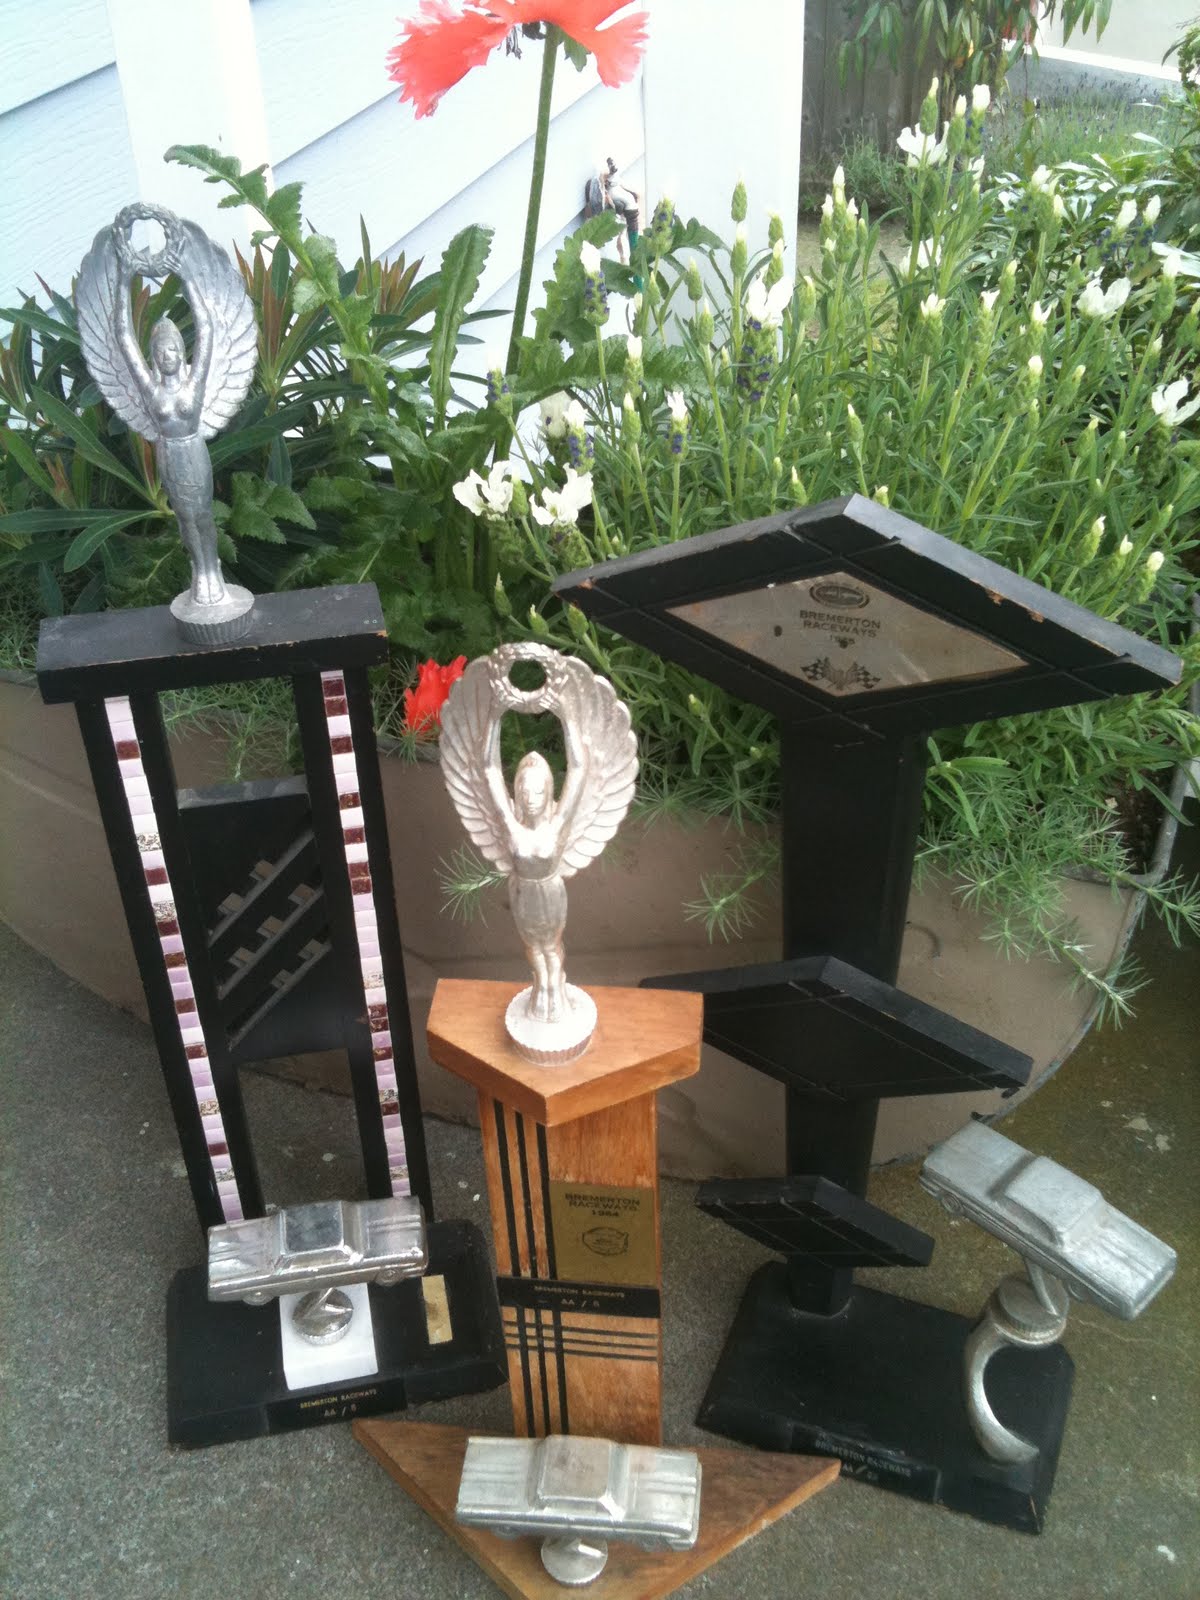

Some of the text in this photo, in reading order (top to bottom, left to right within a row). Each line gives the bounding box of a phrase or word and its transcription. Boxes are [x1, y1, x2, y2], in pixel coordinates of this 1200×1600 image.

[799, 609, 881, 629] BREMERTON
[803, 620, 877, 638] RACEWAYS
[565, 1193, 640, 1206] BREMERTON
[568, 1201, 637, 1211] RACEWAYS
[534, 1286, 625, 1299] BREMERTON RACEWAYS
[299, 1388, 377, 1409] BREMERTON RACEWAYS
[815, 1440, 865, 1462] BREMERTON
